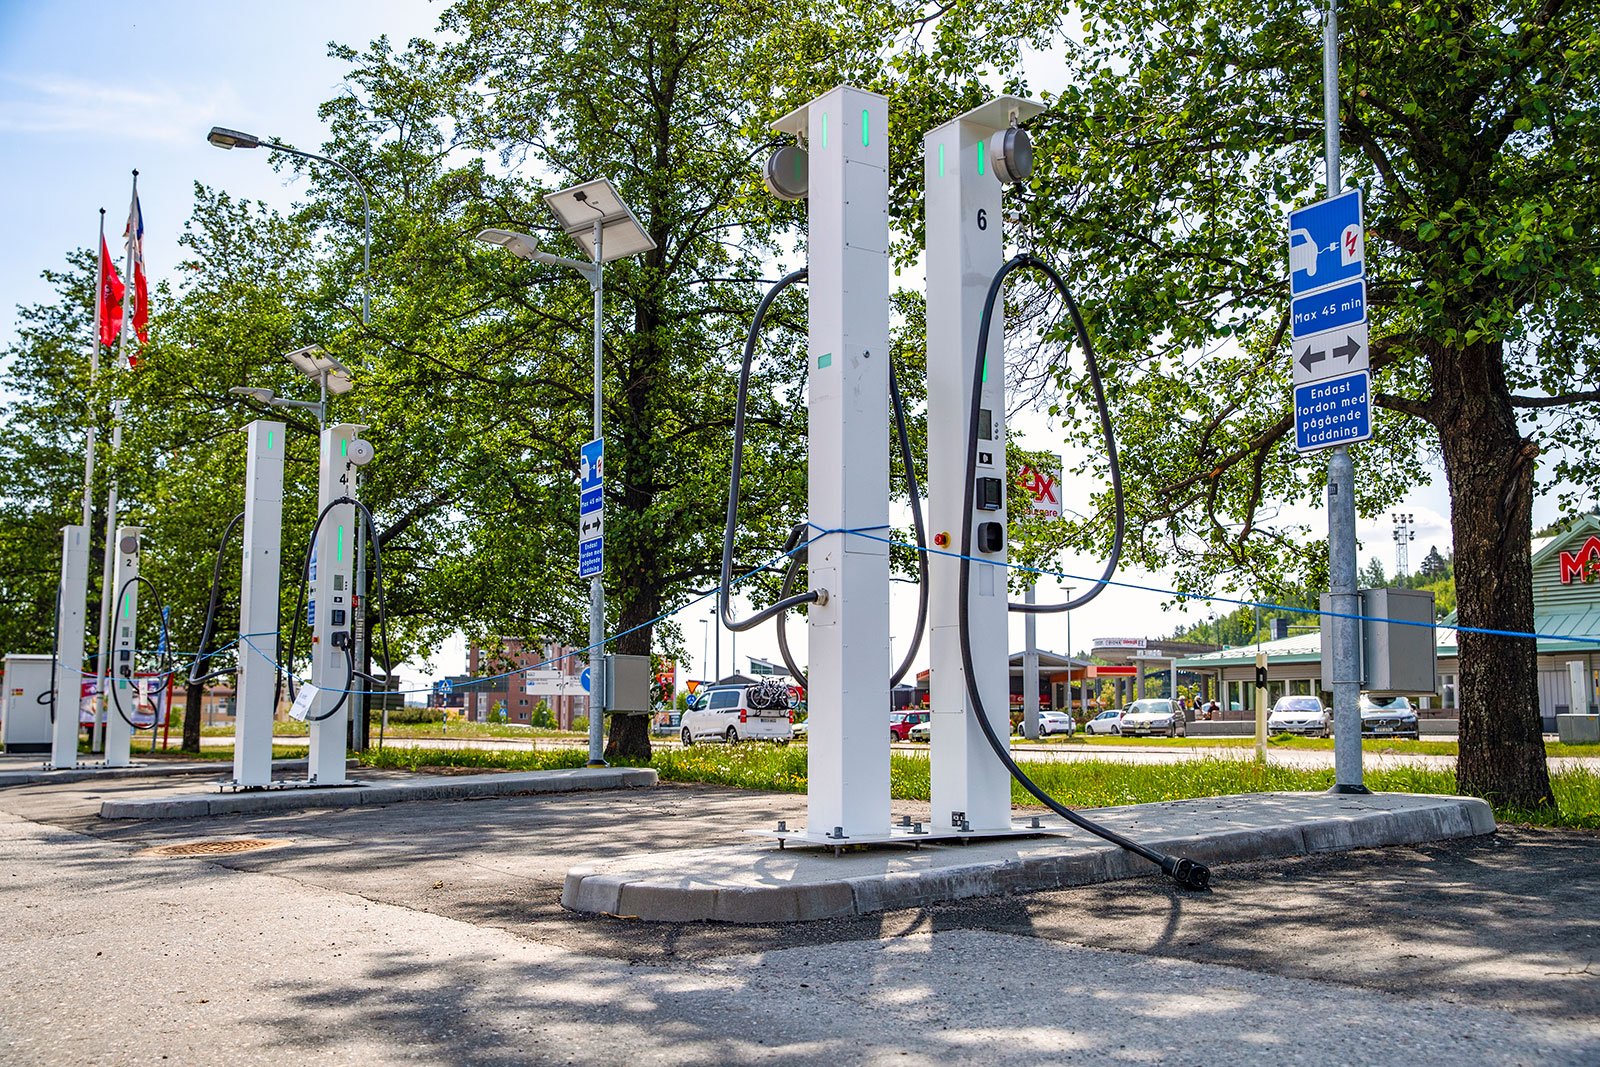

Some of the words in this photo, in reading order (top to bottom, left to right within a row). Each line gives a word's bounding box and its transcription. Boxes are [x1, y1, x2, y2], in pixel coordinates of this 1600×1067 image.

[977, 208, 987, 231] 6
[1295, 311, 1317, 324] Max
[1322, 303, 1336, 316] 45
[1341, 298, 1361, 312] min
[1311, 381, 1350, 399] Endast
[1298, 402, 1336, 416] fordon
[1341, 392, 1366, 408] med
[1303, 410, 1361, 432] pågående
[1307, 426, 1358, 443] laddning
[339, 473, 346, 485] 4
[126, 558, 132, 567] 2
